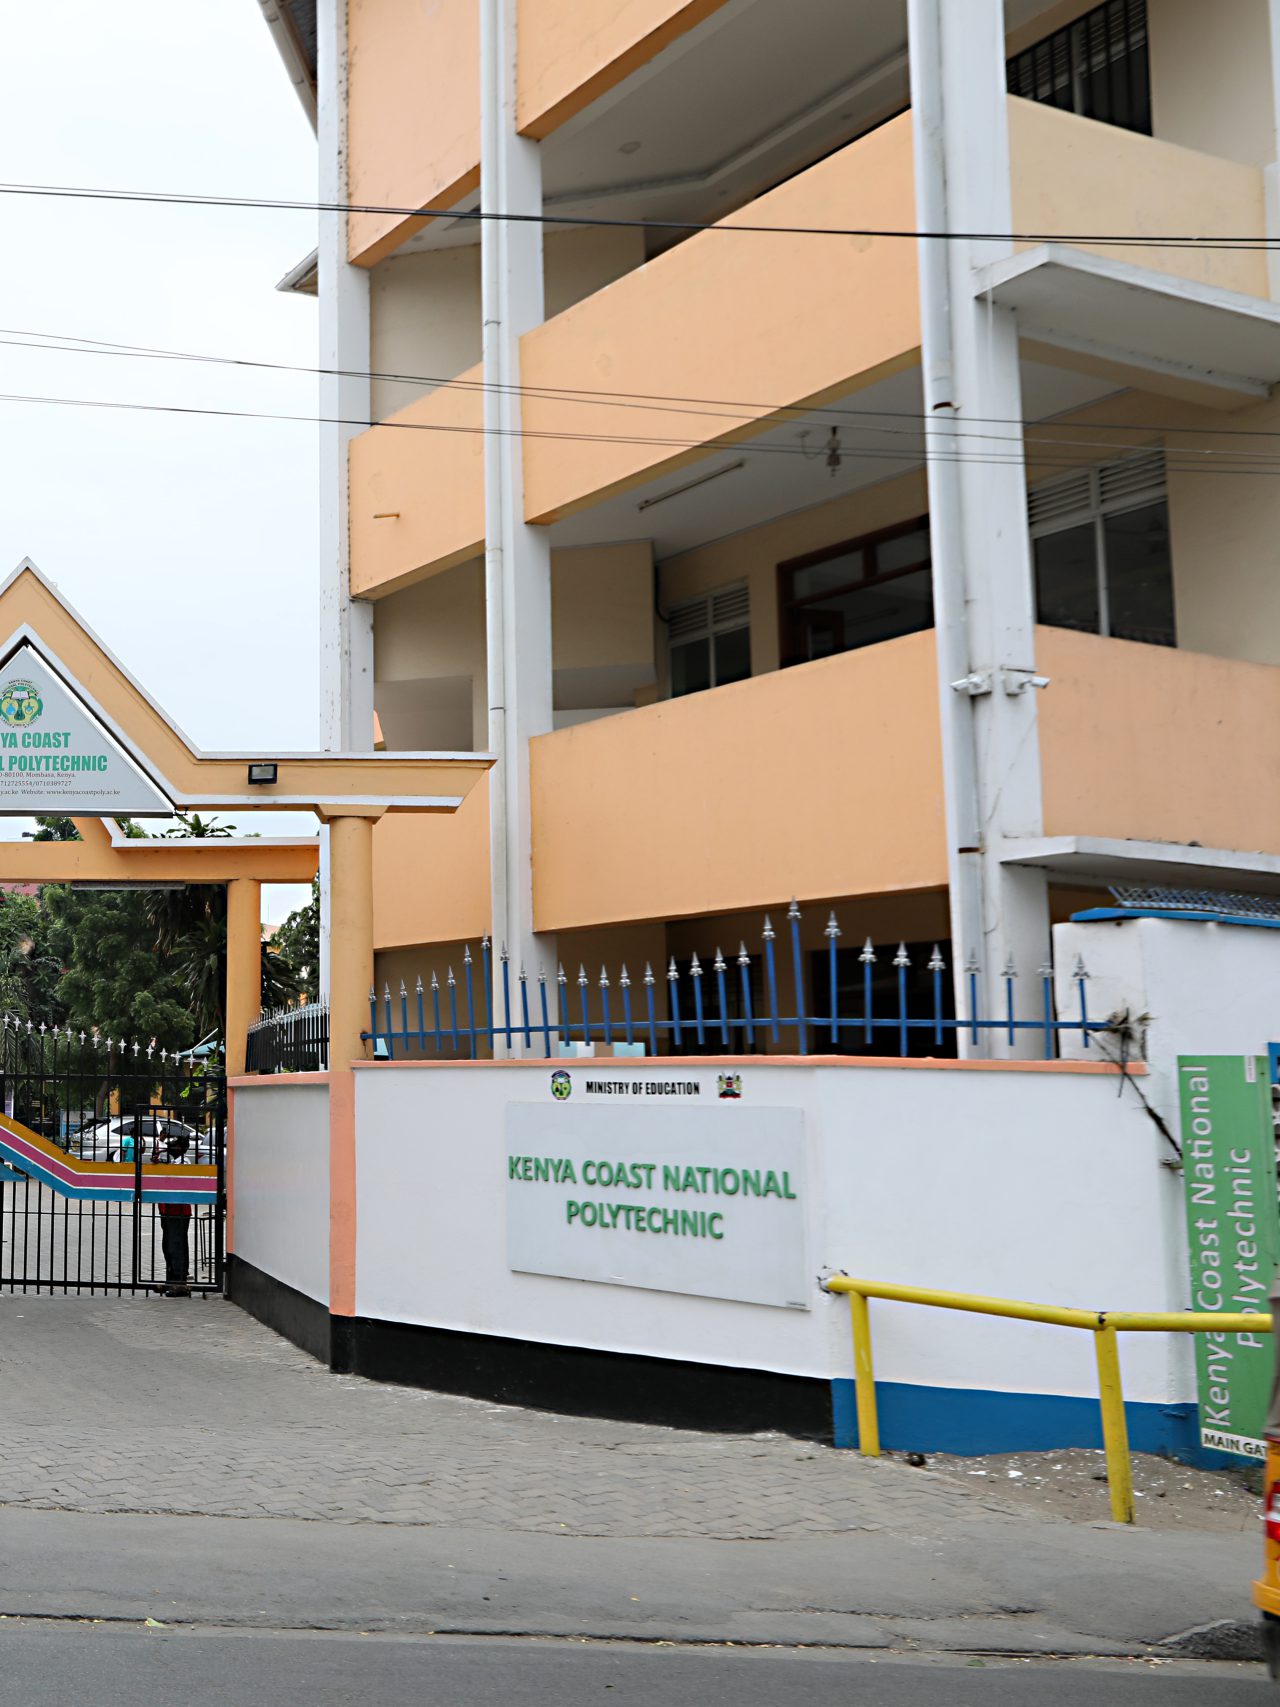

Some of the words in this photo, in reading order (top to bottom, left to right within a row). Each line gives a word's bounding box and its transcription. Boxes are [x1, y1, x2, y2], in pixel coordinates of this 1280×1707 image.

[21, 732, 71, 749] COAST
[8, 755, 108, 772] POLYTECHNIC
[586, 1081, 630, 1095] MINISTRY
[632, 1082, 643, 1096] OF
[645, 1082, 700, 1096] EDUCATION
[1181, 1064, 1218, 1205] National
[508, 1155, 577, 1184] KENYA
[582, 1160, 657, 1191] COAST
[662, 1164, 797, 1201] NATIONAL
[566, 1200, 724, 1240] POLYTECHNIC
[1192, 1217, 1224, 1311] Coast
[1204, 1433, 1241, 1452] MAIN
